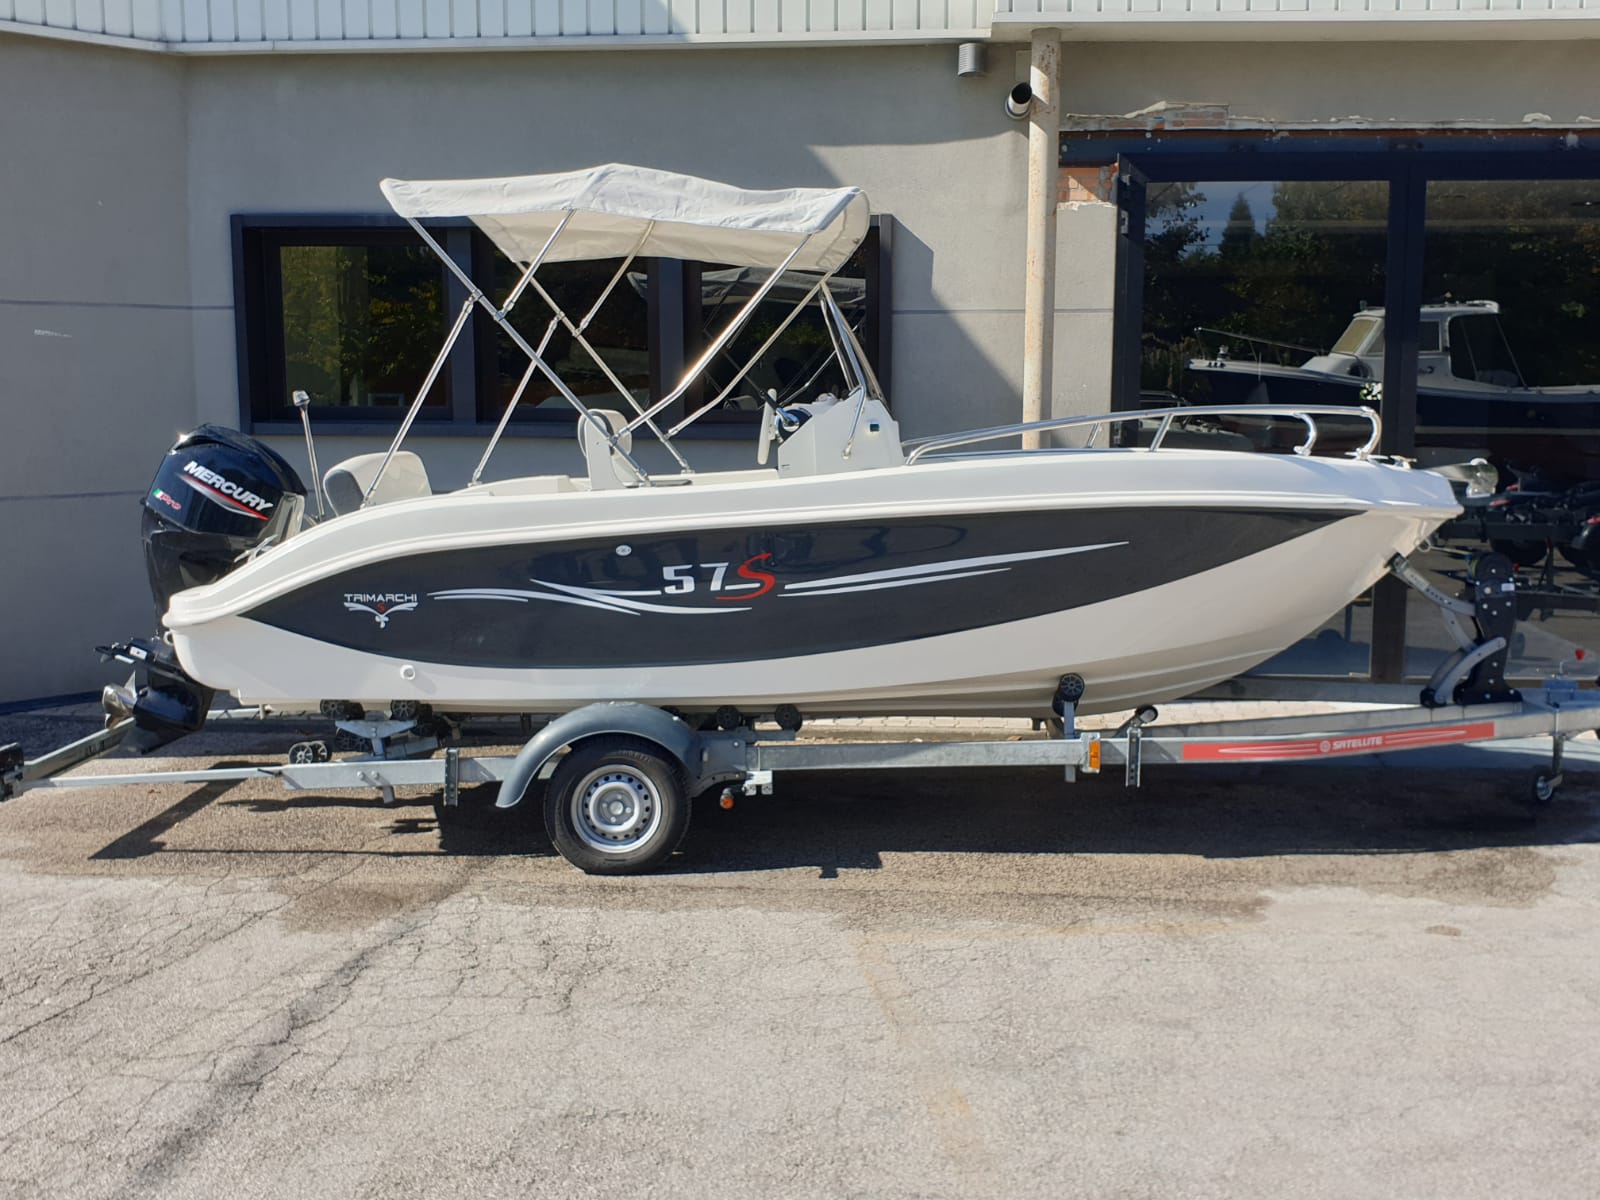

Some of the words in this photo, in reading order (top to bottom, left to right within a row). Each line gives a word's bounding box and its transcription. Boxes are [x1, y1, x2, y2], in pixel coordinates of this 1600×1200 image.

[183, 460, 274, 511] MERCURY
[344, 593, 418, 602] TRIMARCHI
[1332, 736, 1383, 751] SATELLITE
